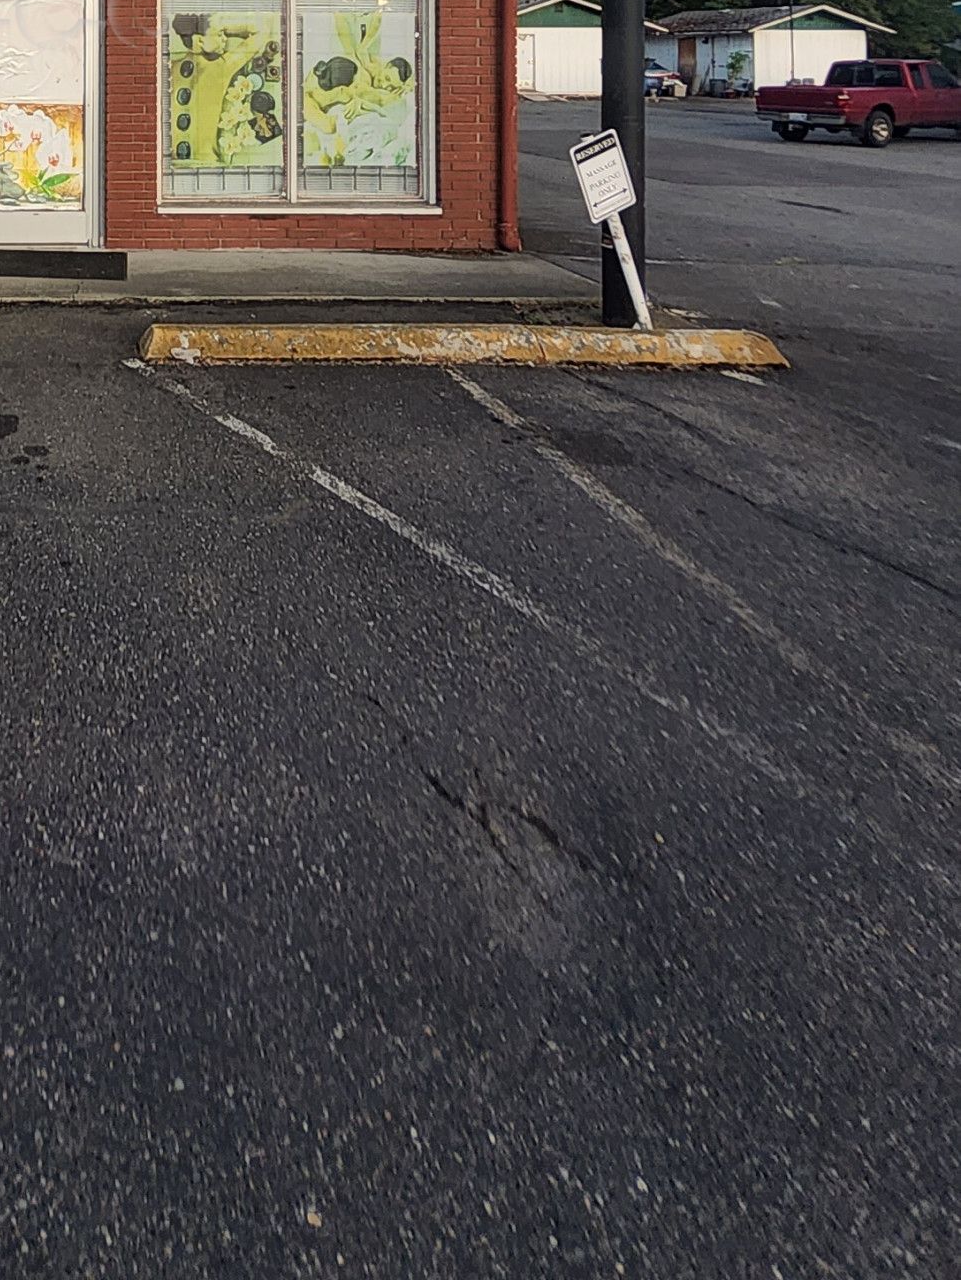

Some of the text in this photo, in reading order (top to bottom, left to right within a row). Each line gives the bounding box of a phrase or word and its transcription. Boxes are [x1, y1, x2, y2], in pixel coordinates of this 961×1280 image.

[574, 136, 616, 161] RESERVED
[589, 171, 622, 192] PARKING
[597, 183, 619, 198] ONLY
